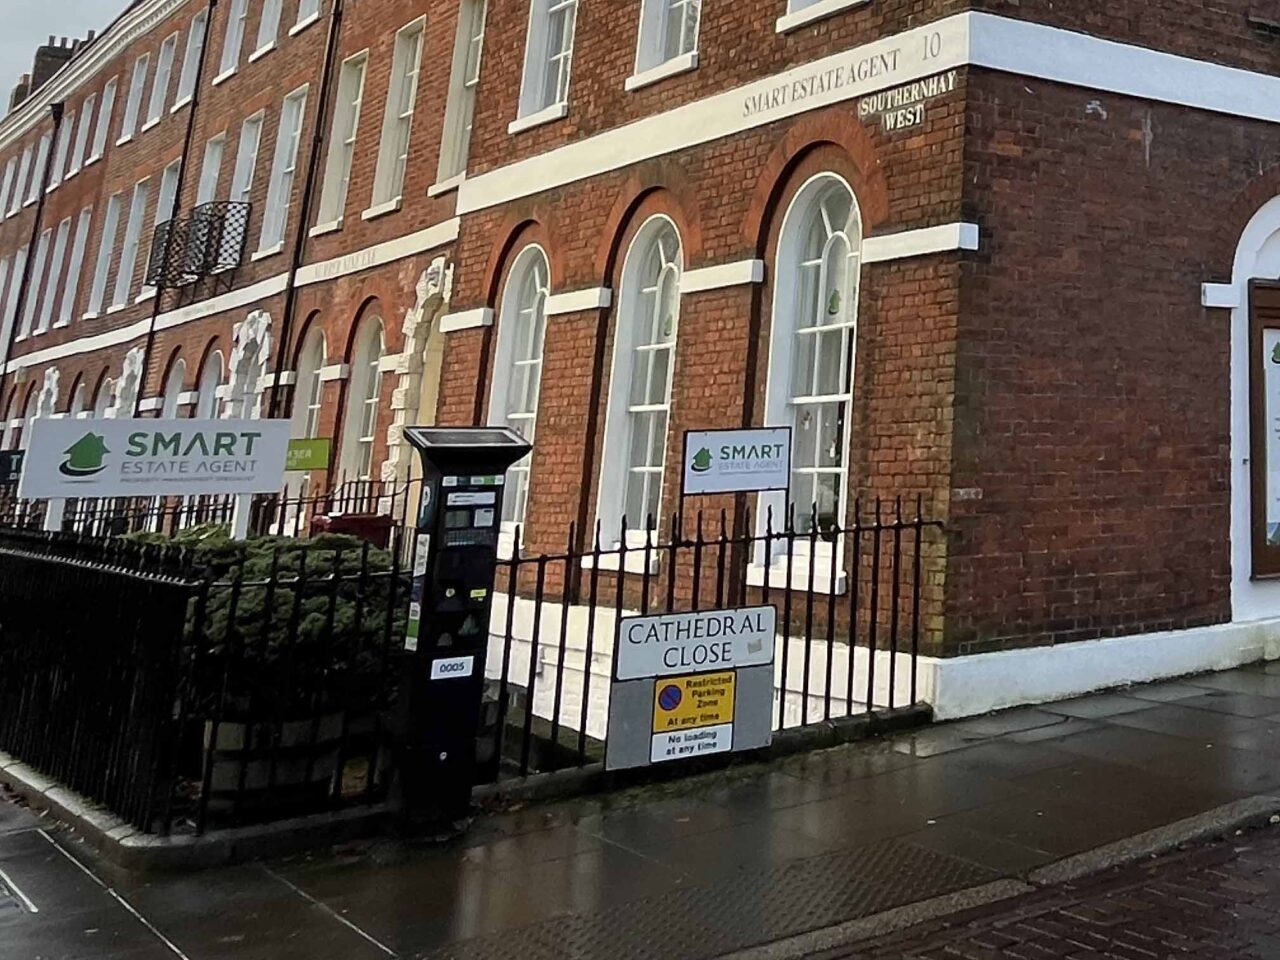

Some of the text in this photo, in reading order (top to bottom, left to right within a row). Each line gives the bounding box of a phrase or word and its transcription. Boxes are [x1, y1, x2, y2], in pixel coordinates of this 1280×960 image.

[743, 85, 789, 118] SMART
[791, 67, 845, 102] ESTATE
[847, 49, 901, 82] AGENT
[860, 70, 958, 116] SOUTHERNHAY
[884, 104, 925, 131] WEST
[126, 431, 262, 457] SMART
[720, 444, 784, 460] SMART
[120, 459, 258, 474] ESTATE AGENT
[718, 461, 753, 471] ESTATE
[628, 613, 767, 644] CATHEDRAL
[663, 642, 732, 668] CLOSE
[686, 675, 732, 689] Restricted
[692, 688, 725, 698] Parking
[697, 700, 718, 708] Zone
[667, 713, 719, 726] At any time
[668, 731, 717, 744] No loading
[666, 741, 717, 755] at any time
